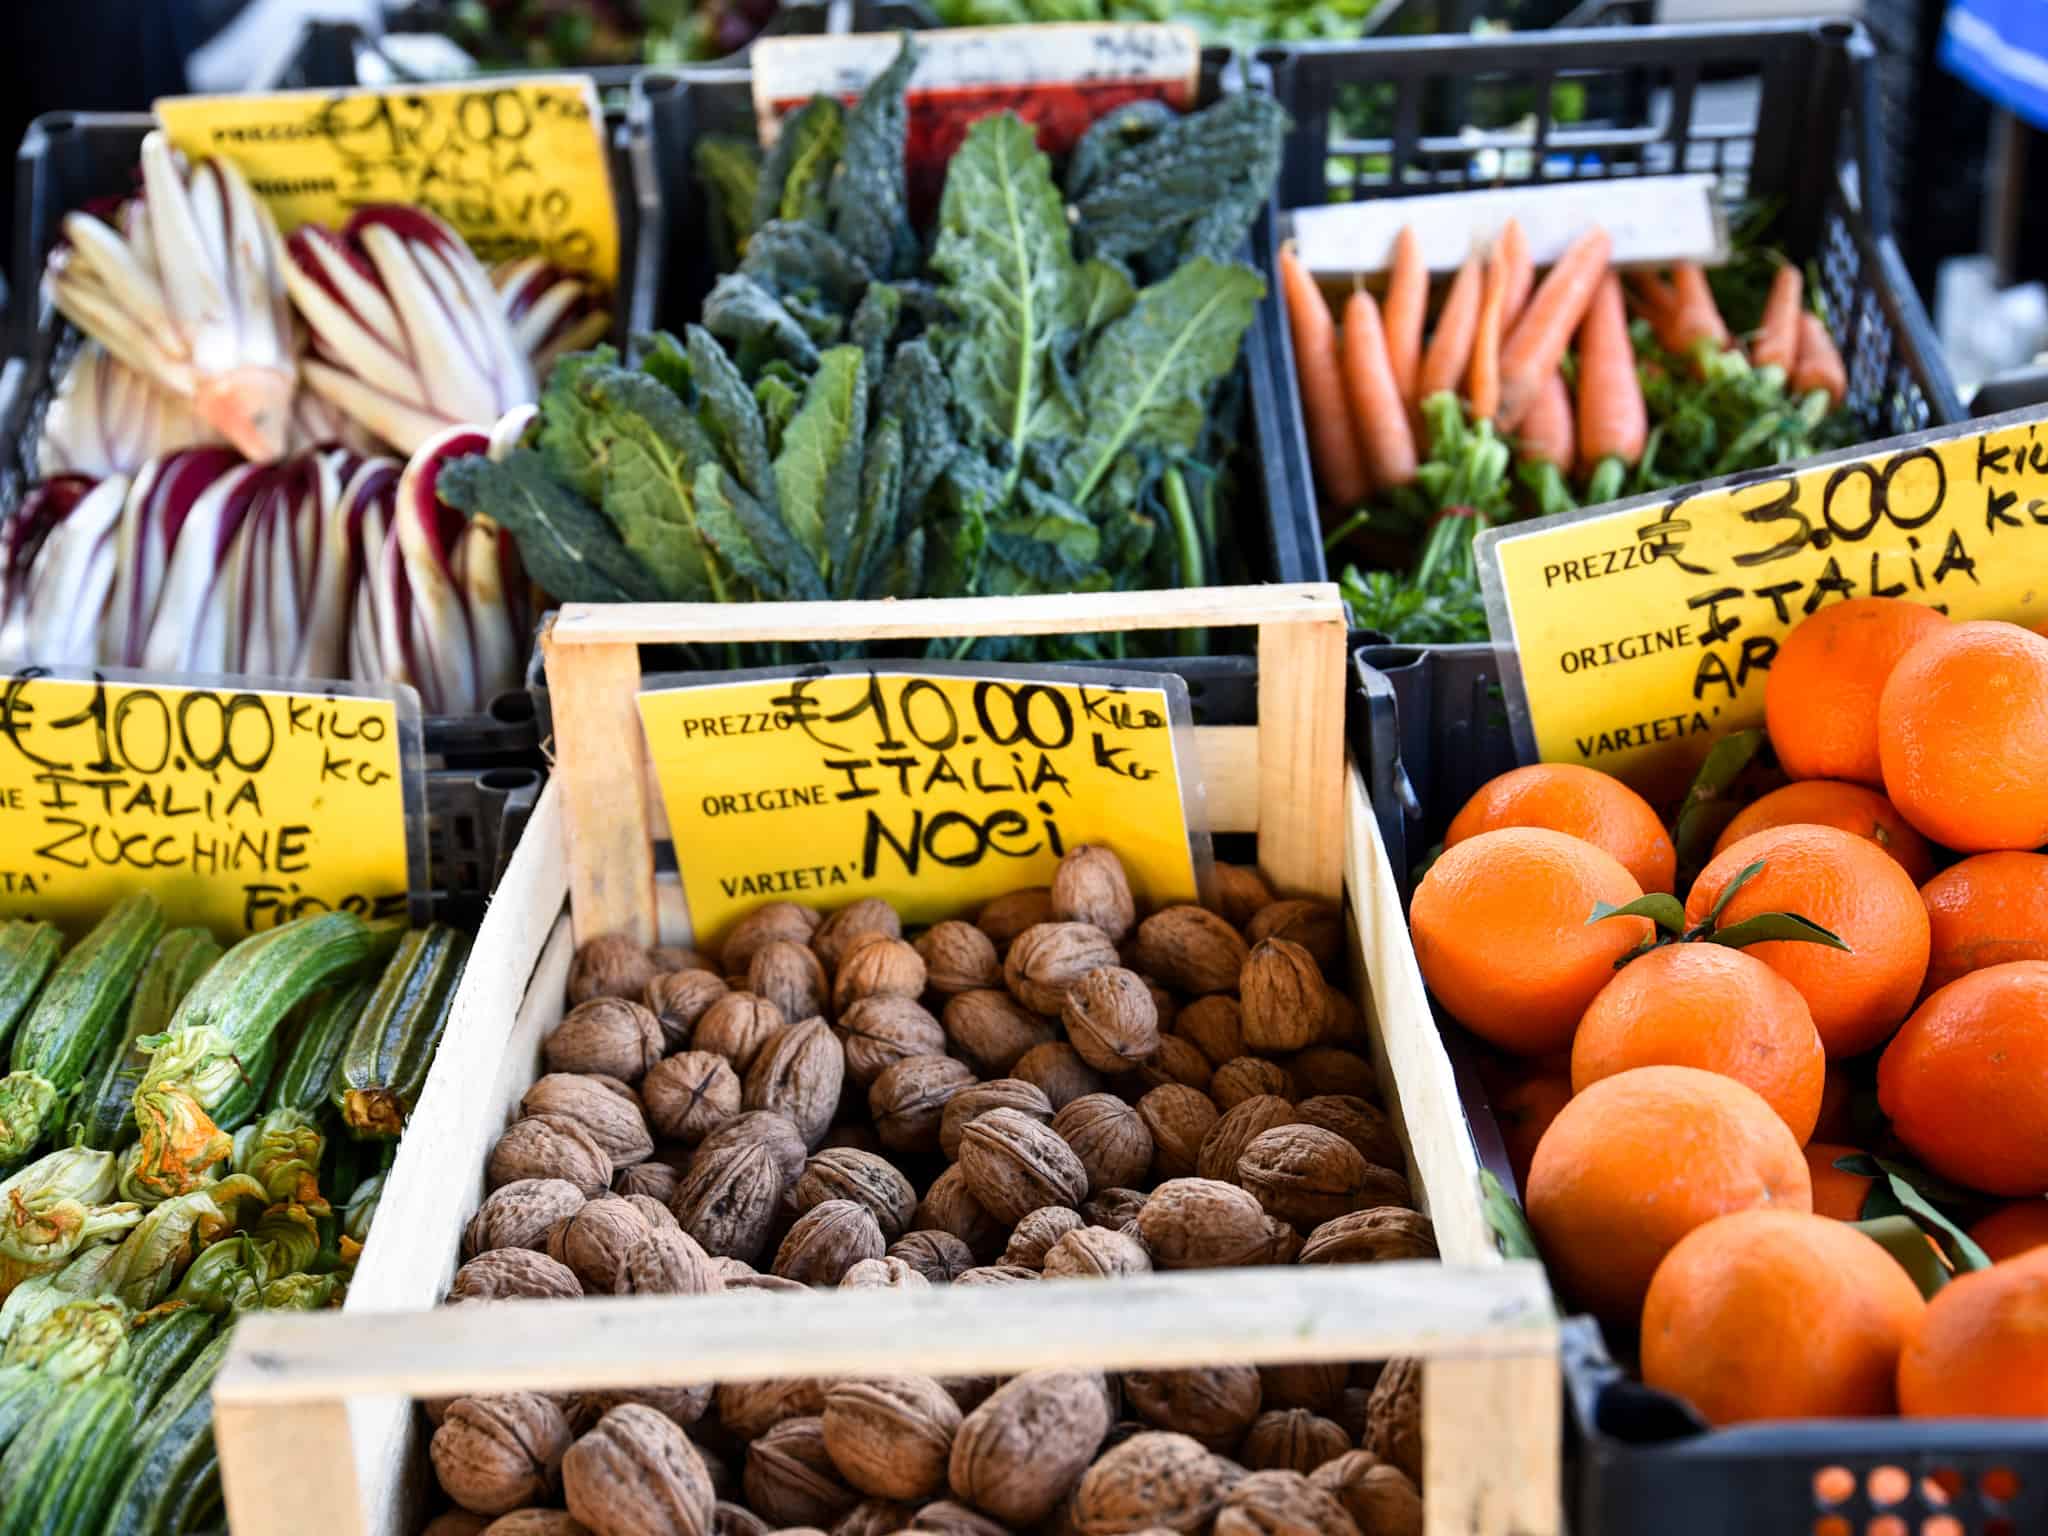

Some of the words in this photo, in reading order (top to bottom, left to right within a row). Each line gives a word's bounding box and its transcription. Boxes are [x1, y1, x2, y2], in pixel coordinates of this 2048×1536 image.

[1545, 541, 1658, 587] PREZZO
[1561, 623, 1692, 674] ORIGINE
[683, 711, 793, 738] PREZZO
[1577, 706, 1721, 757] VARIETA'
[702, 785, 826, 816] ORIGINE
[720, 862, 857, 899] VARIETA'
